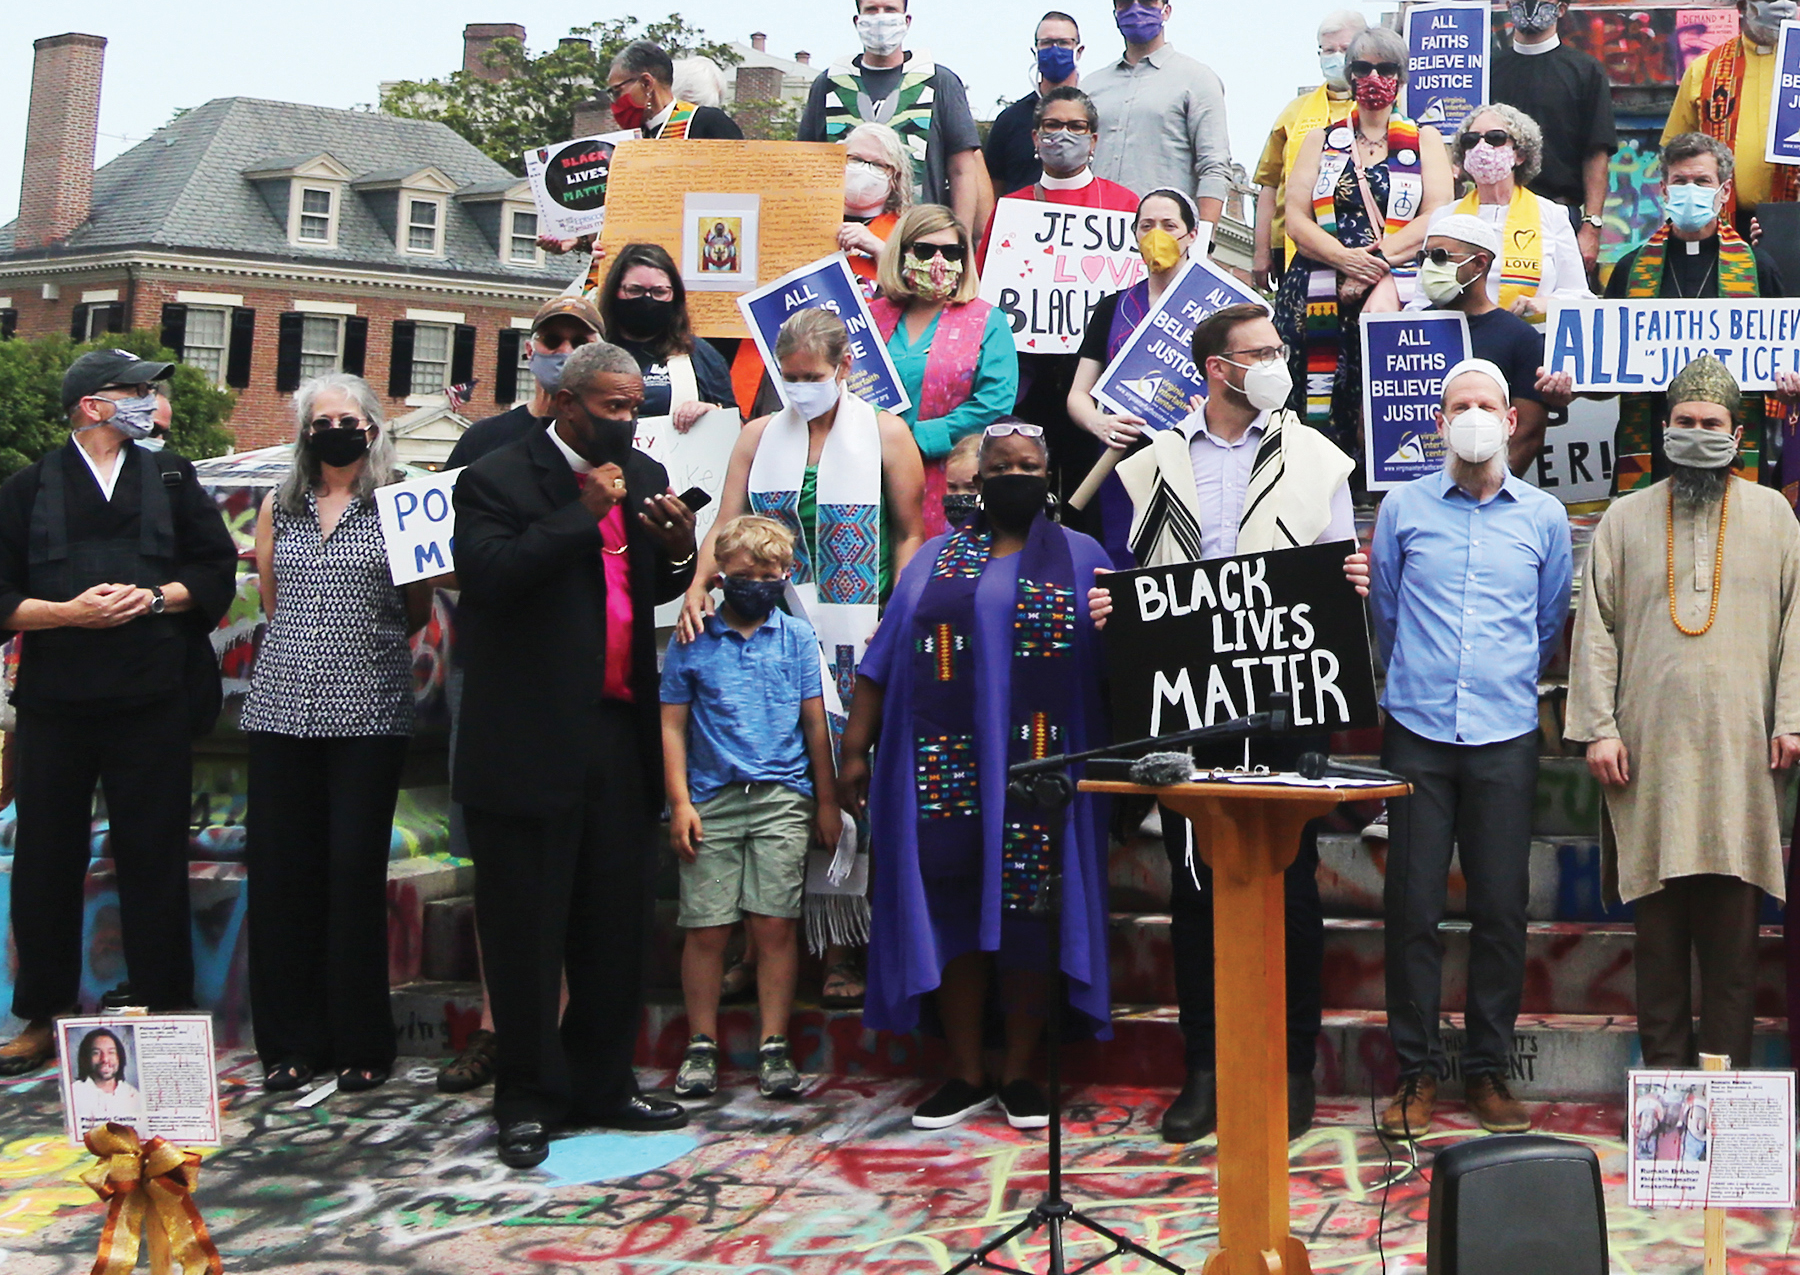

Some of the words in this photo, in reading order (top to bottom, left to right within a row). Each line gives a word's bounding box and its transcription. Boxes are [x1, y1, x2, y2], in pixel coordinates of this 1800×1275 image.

[1431, 15, 1458, 30] ALL
[1421, 35, 1469, 50] FAITHS
[1408, 56, 1464, 71] BELIEVE
[1467, 54, 1482, 68] IN
[1415, 74, 1473, 90] JUSTICE
[561, 150, 608, 168] BLACK
[566, 166, 608, 185] LIVES
[563, 183, 606, 202] MATTE
[1504, 259, 1539, 270] LOVE
[785, 284, 818, 311] ALL
[1397, 329, 1431, 346] ALL
[1551, 307, 1643, 385] ALL
[1635, 309, 1720, 341] FAITHS
[1386, 353, 1446, 371] FAITHS
[1371, 378, 1442, 397] BELIEVE
[1383, 404, 1441, 422] JUSTIC
[1134, 557, 1273, 622] BLACK
[1212, 603, 1315, 653] LIVES
[1150, 649, 1350, 738] MATTER
